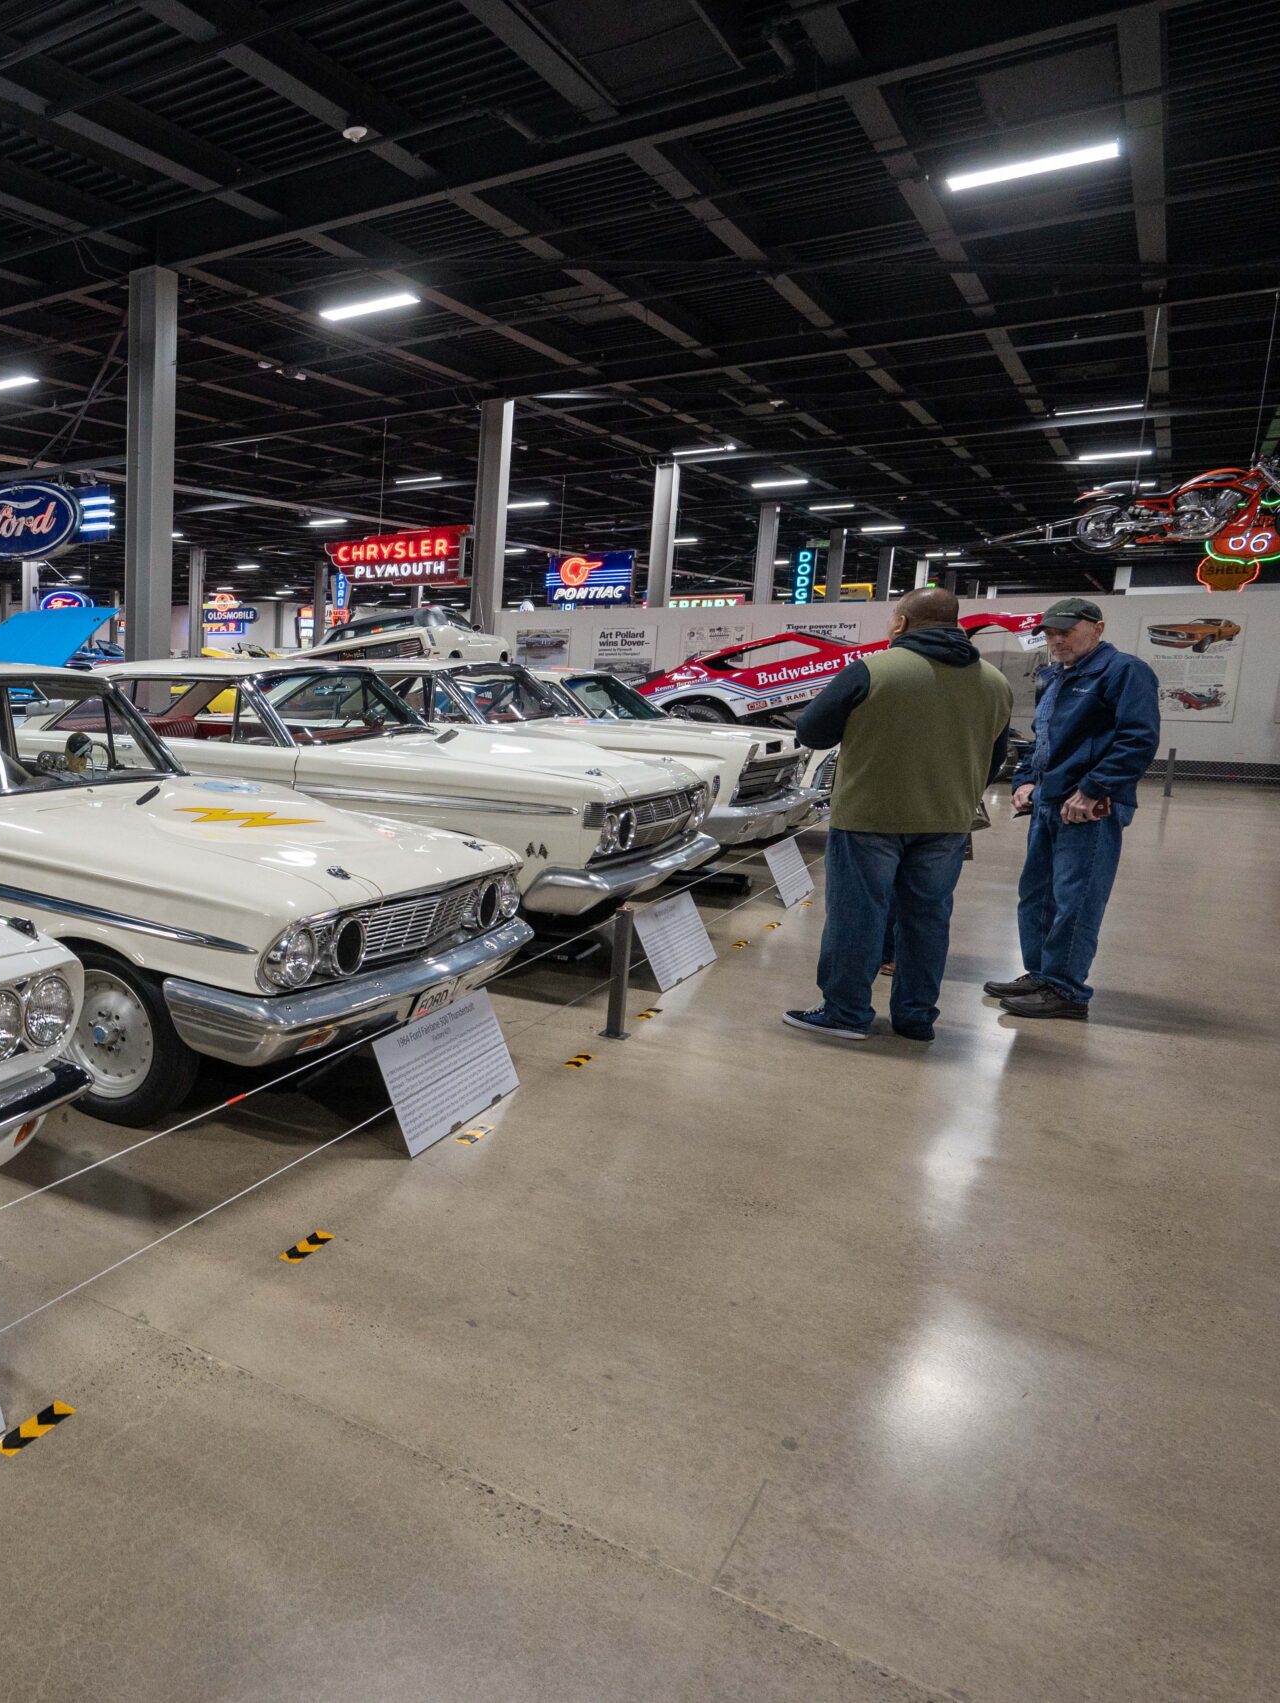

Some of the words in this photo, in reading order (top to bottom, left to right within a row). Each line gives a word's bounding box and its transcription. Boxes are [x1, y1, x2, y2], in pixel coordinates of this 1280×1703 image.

[1228, 532, 1271, 553] 66
[337, 539, 449, 562] CHRYSLER
[354, 561, 446, 579] PLYMOUTH
[1206, 566, 1250, 576] SHELL
[553, 585, 627, 601] PONTIAC
[207, 611, 254, 620] OLDSMOBILE
[786, 623, 807, 631] Tiger
[599, 631, 613, 639] Art
[615, 631, 645, 639] Pollard
[599, 639, 618, 647] wins
[756, 659, 841, 685] Budweiser
[655, 684, 675, 692] Kenny
[786, 693, 806, 701] RAM
[418, 990, 449, 1012] FORD
[397, 1035, 410, 1048] 1964
[410, 1029, 422, 1041] Ford
[421, 1021, 440, 1037] Fairlane
